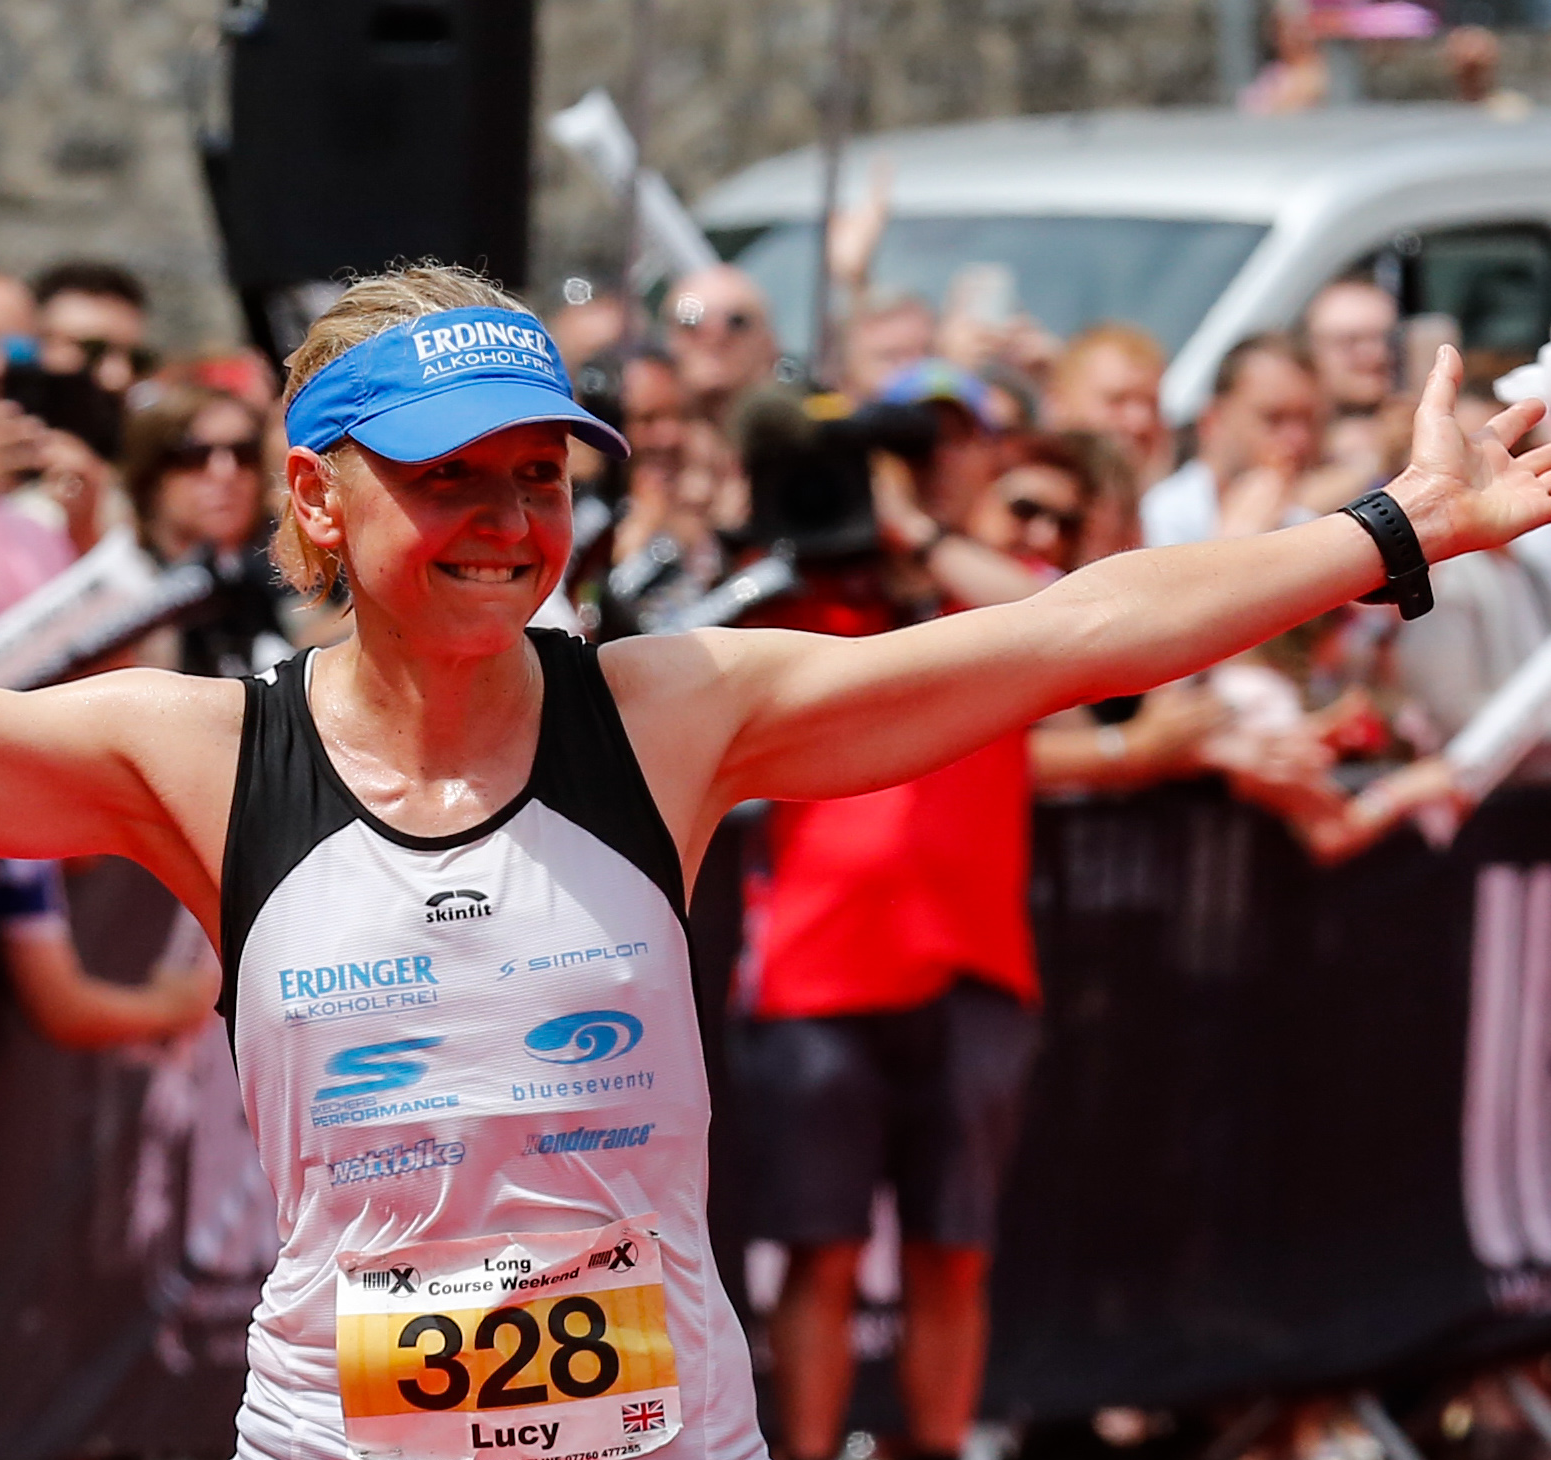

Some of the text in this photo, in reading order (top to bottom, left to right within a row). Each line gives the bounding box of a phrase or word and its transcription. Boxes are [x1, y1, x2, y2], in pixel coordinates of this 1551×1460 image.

[412, 321, 554, 363] ERDINGER
[422, 351, 556, 380] ALKOHOLFREI
[425, 903, 492, 923] skinfit
[528, 942, 648, 972] SIMPLON
[278, 955, 440, 1001] ERDINGER
[284, 990, 438, 1023] ALKOHOLFREI
[512, 1070, 655, 1101] blueseventy
[310, 1096, 377, 1116] SKECHERS
[313, 1095, 460, 1128] PERFORMANCE
[327, 1138, 466, 1186] wattbike
[484, 1258, 532, 1274] Long
[428, 1267, 581, 1296] Course Weekend
[397, 1296, 620, 1411] 328
[471, 1421, 560, 1450] Lucy
